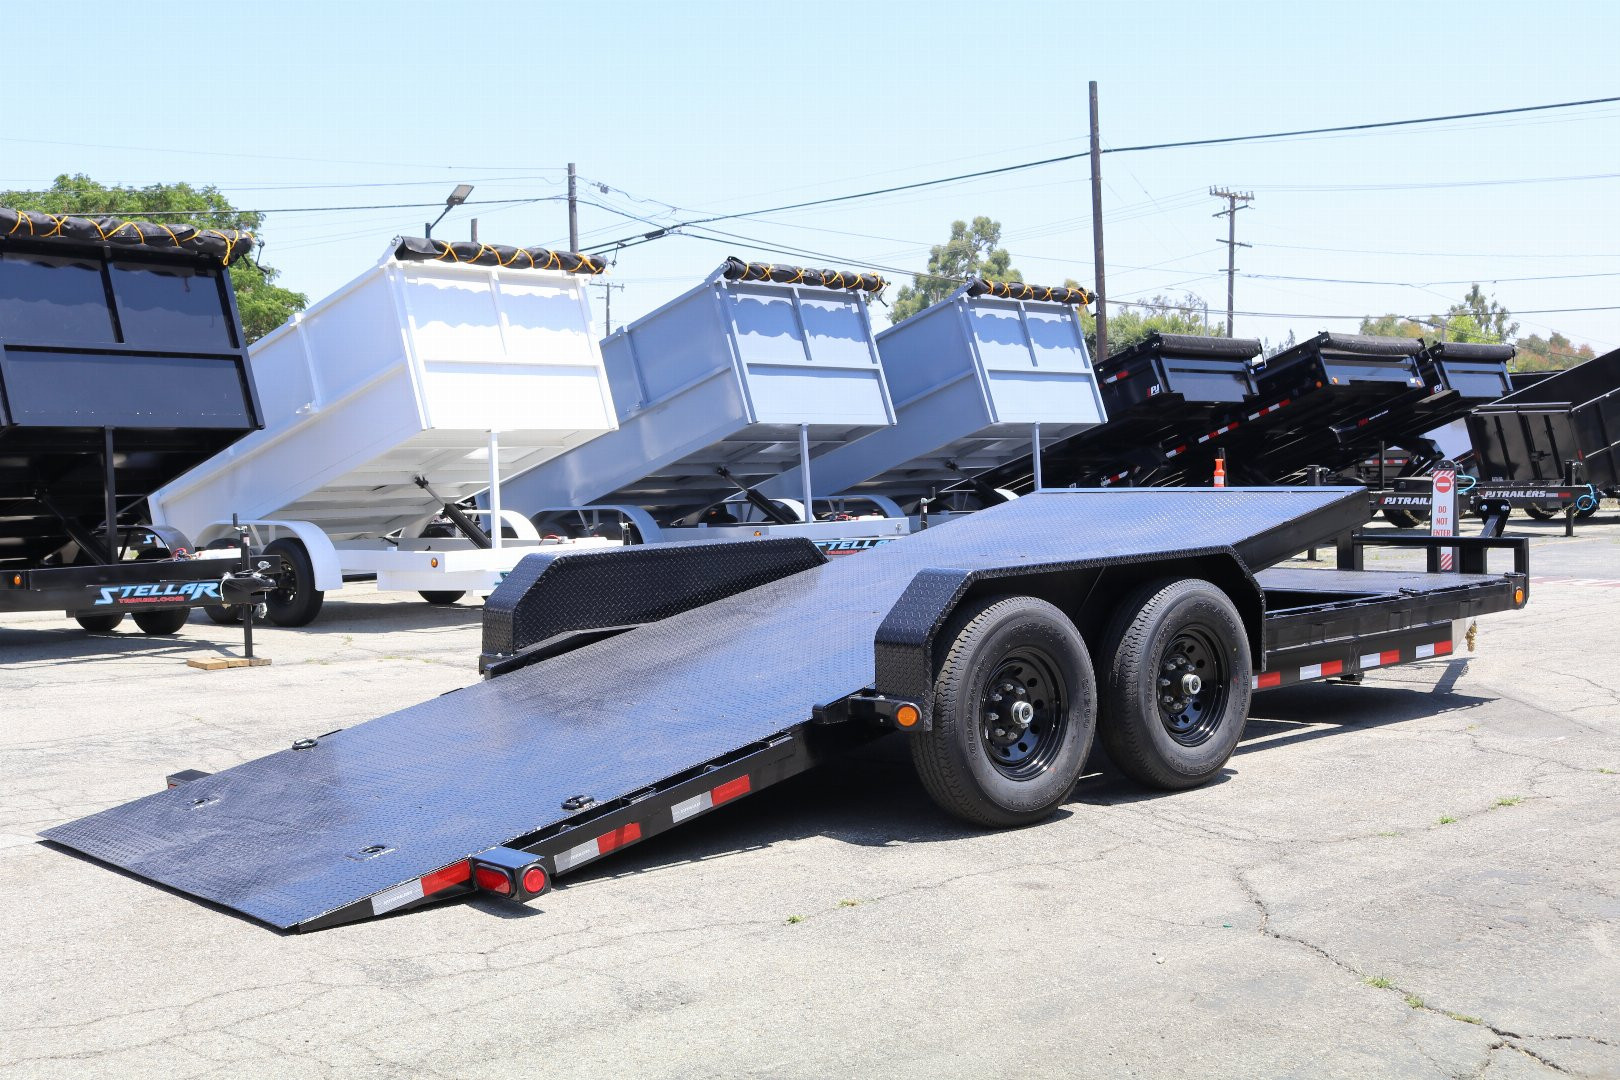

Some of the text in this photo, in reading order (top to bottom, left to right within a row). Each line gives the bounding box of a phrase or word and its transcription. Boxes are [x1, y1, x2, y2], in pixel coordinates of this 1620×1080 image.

[1438, 505, 1447, 514] DO
[1436, 517, 1449, 526] NOT
[1433, 529, 1451, 537] ENTER
[94, 582, 222, 606] STELLAR
